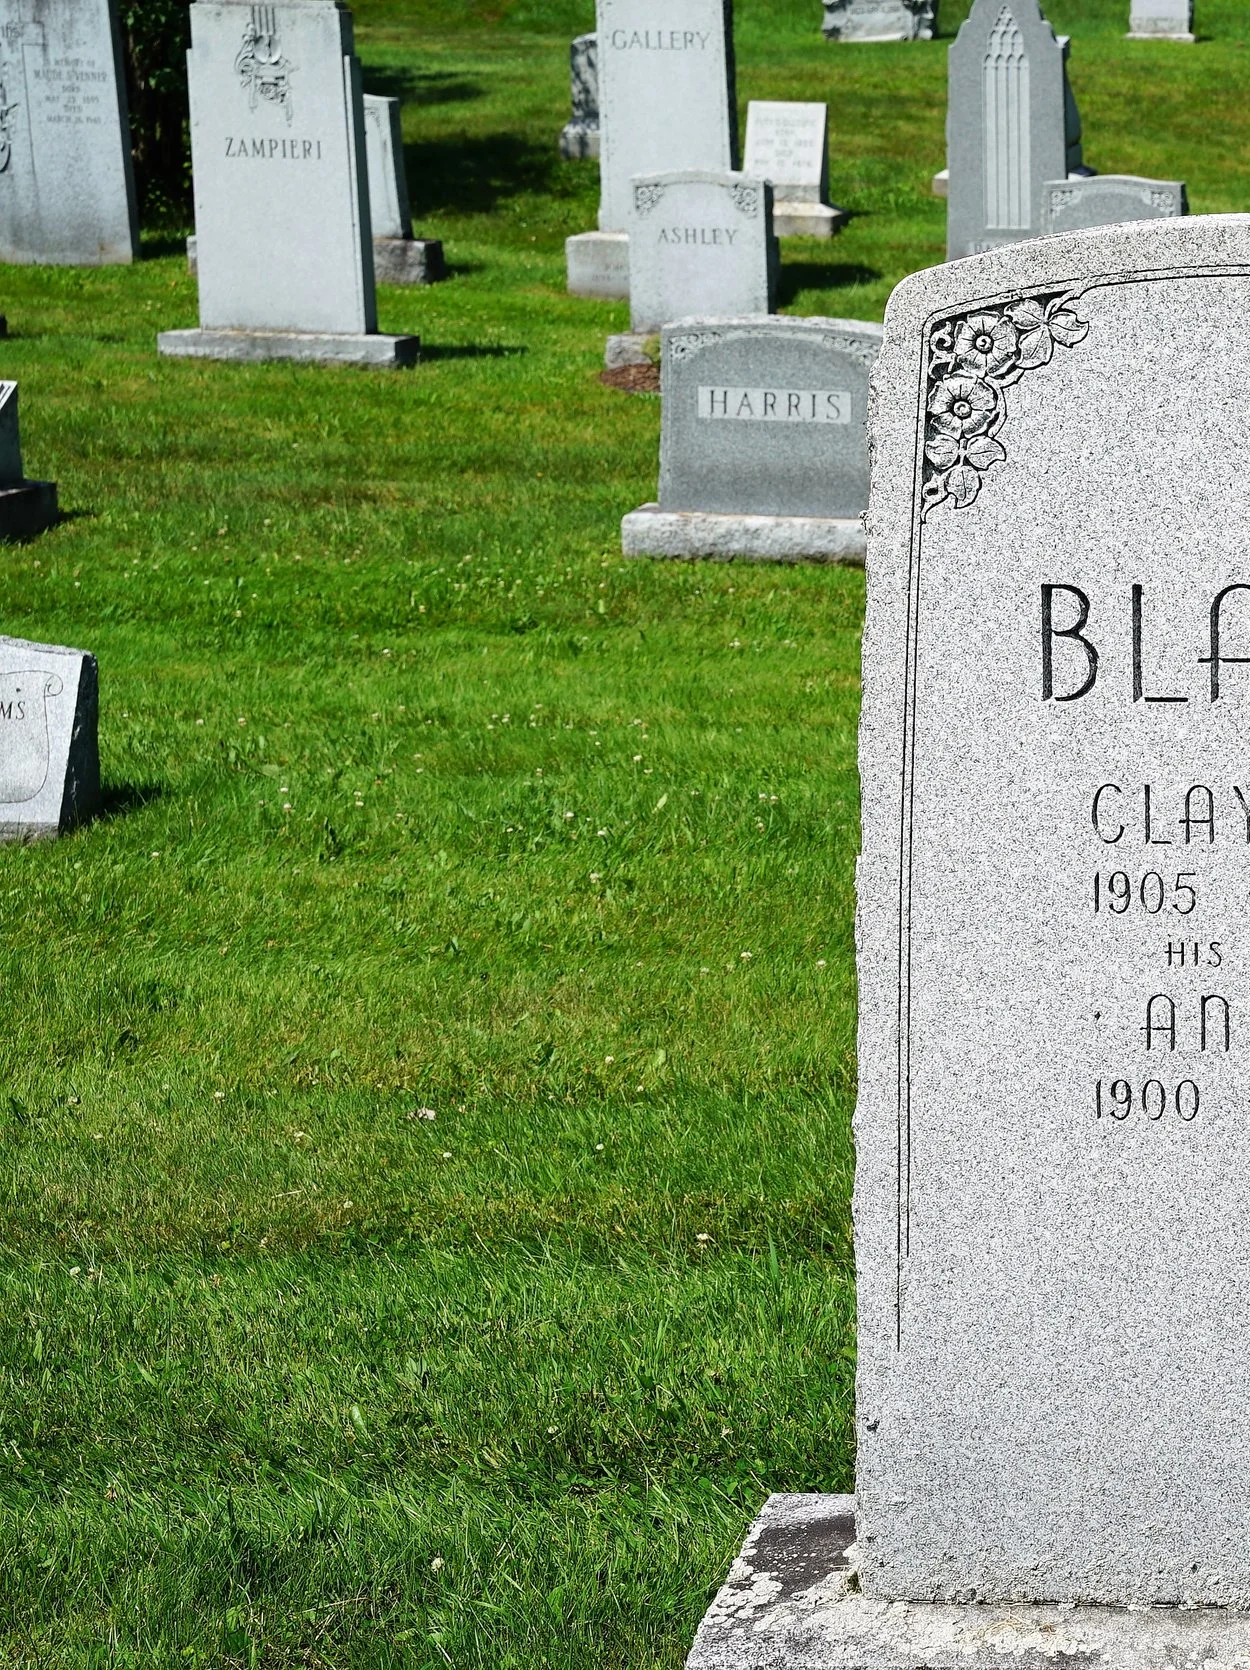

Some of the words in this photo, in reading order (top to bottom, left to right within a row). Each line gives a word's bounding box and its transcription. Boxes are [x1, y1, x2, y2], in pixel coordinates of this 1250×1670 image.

[611, 29, 712, 50] GALLERY
[225, 136, 322, 160] ZAMPIERI
[658, 227, 739, 245] ASHLEY
[710, 389, 841, 420] HARRIS
[1094, 870, 1197, 915] 1905
[1164, 941, 1223, 968] HIS
[1095, 1079, 1200, 1121] 1900
